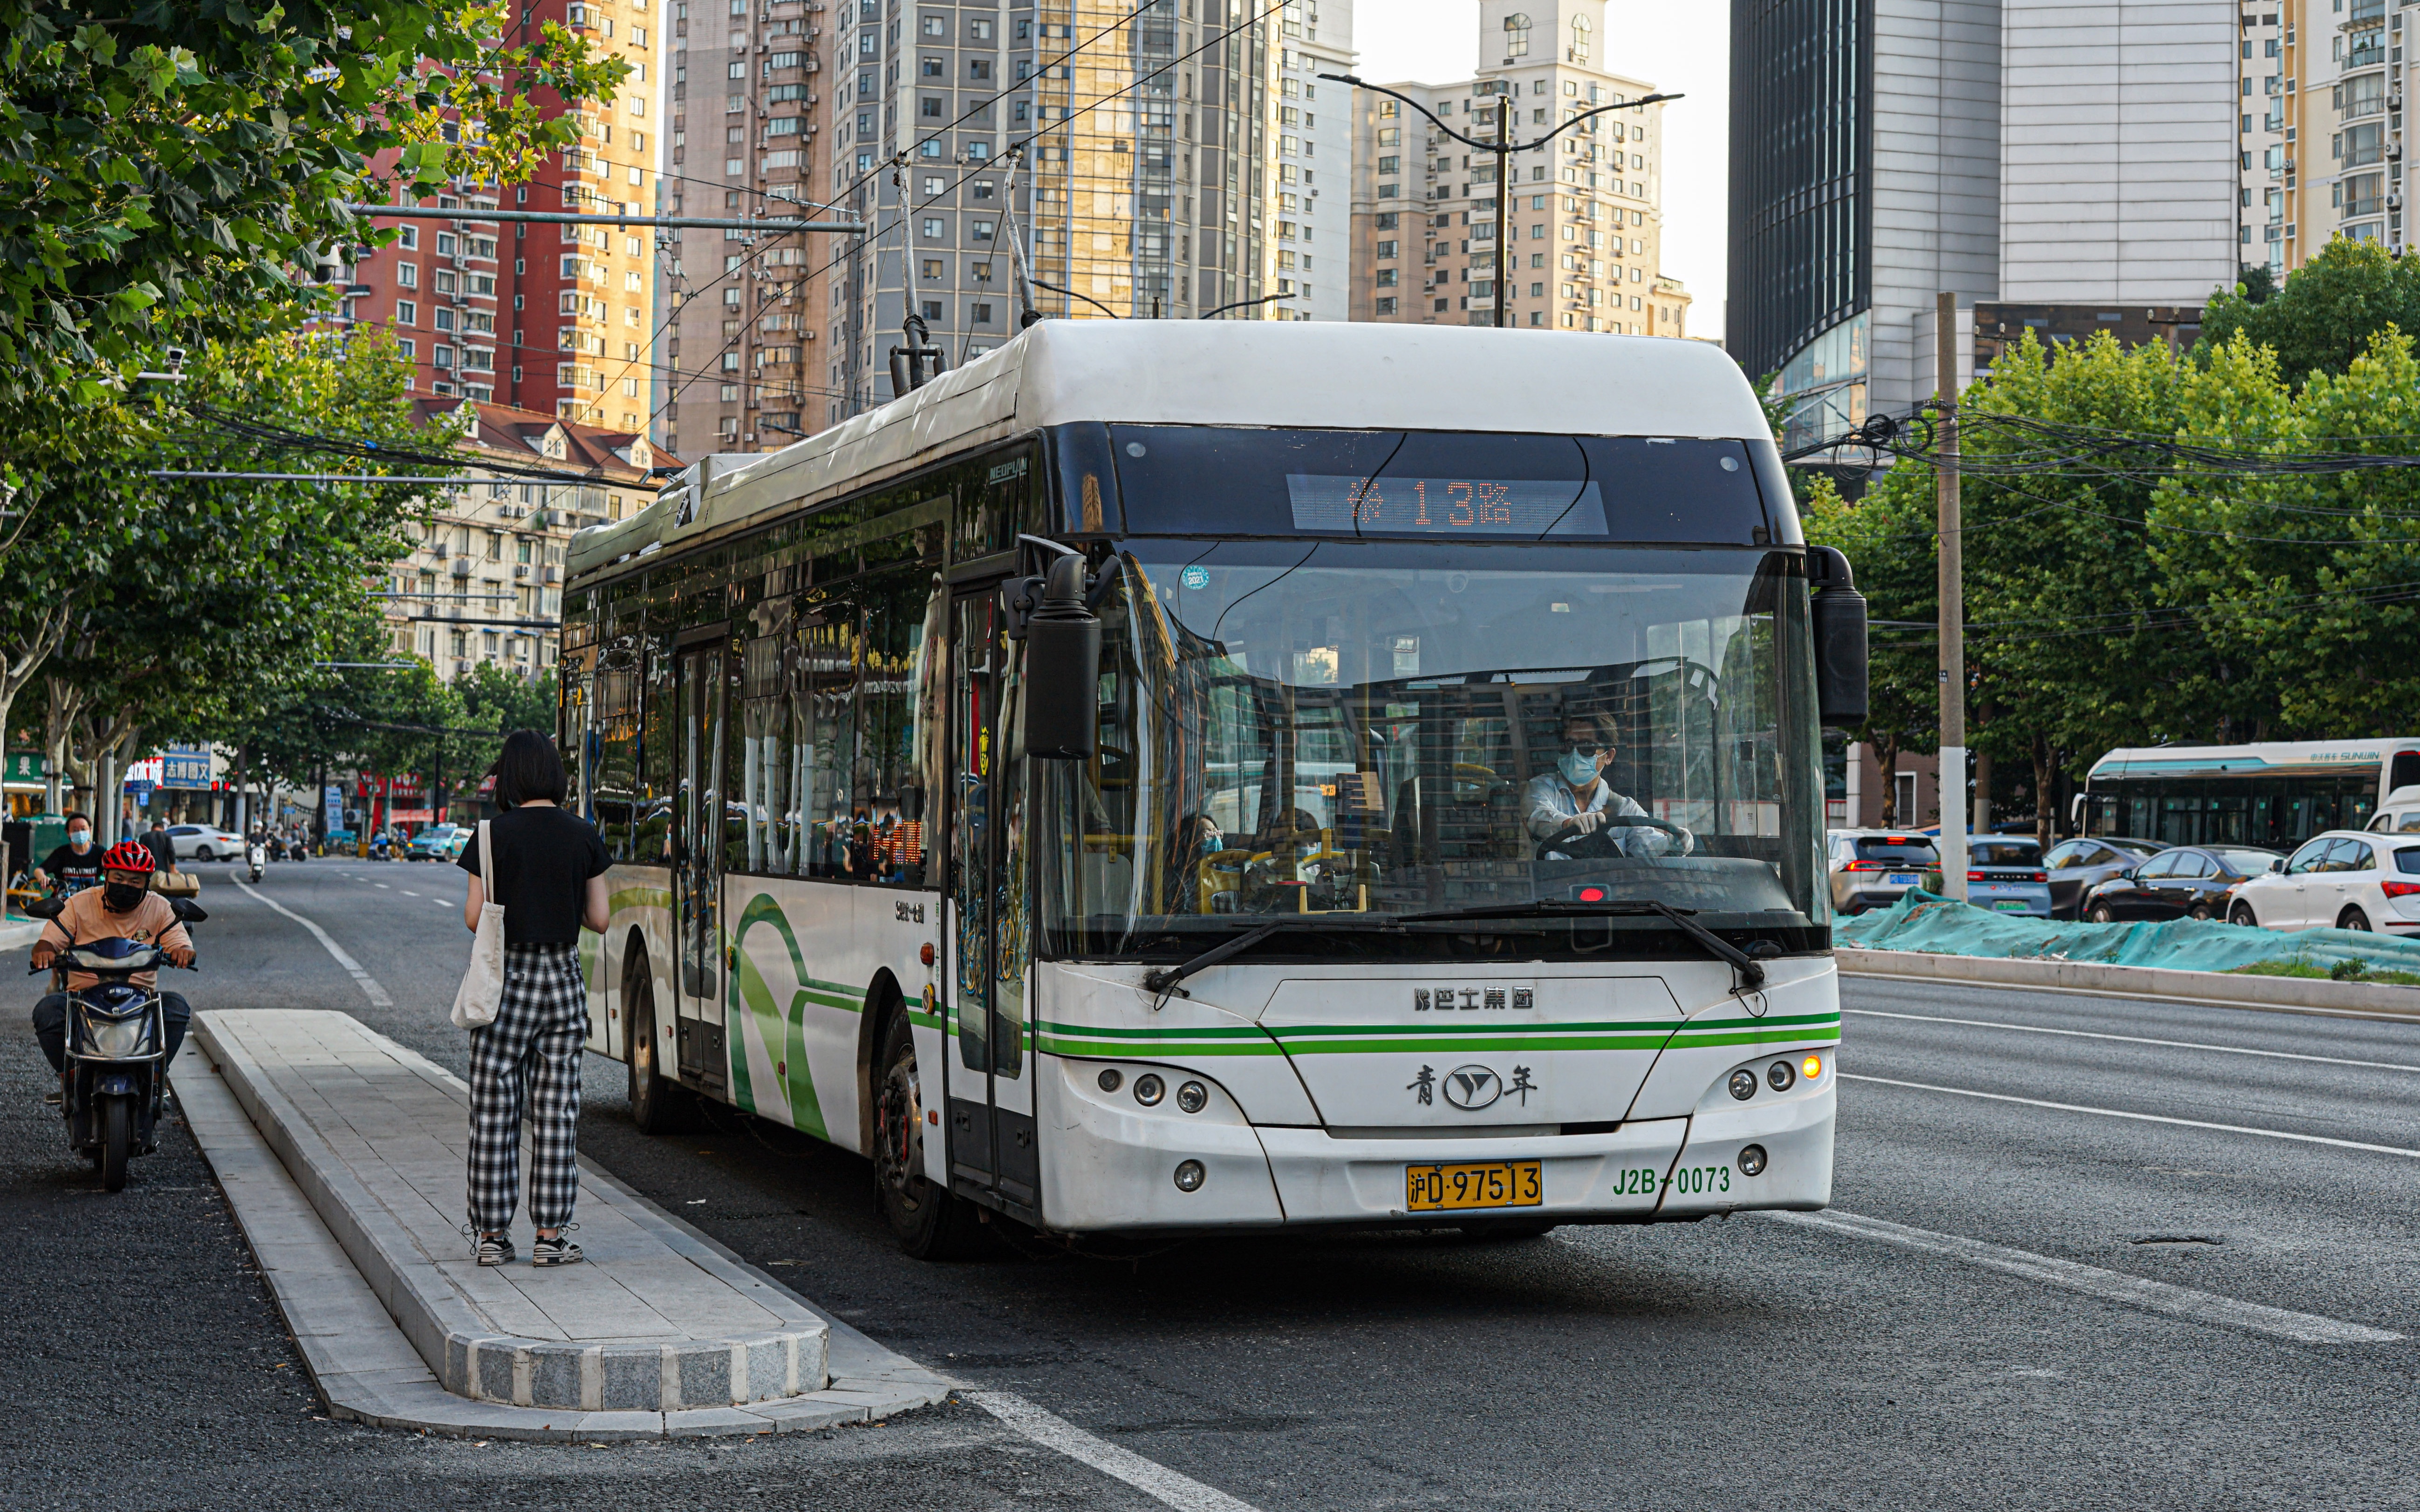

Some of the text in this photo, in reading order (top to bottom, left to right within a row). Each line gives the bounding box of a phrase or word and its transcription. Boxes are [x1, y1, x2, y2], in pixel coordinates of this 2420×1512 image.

[990, 457, 1027, 482] NEOPLAN
[1188, 575, 1203, 585] 2021
[2340, 751, 2380, 761] SUNWIN
[1435, 987, 1533, 1010] 巴士集团
[1613, 1166, 1730, 1195] J2B-0073
